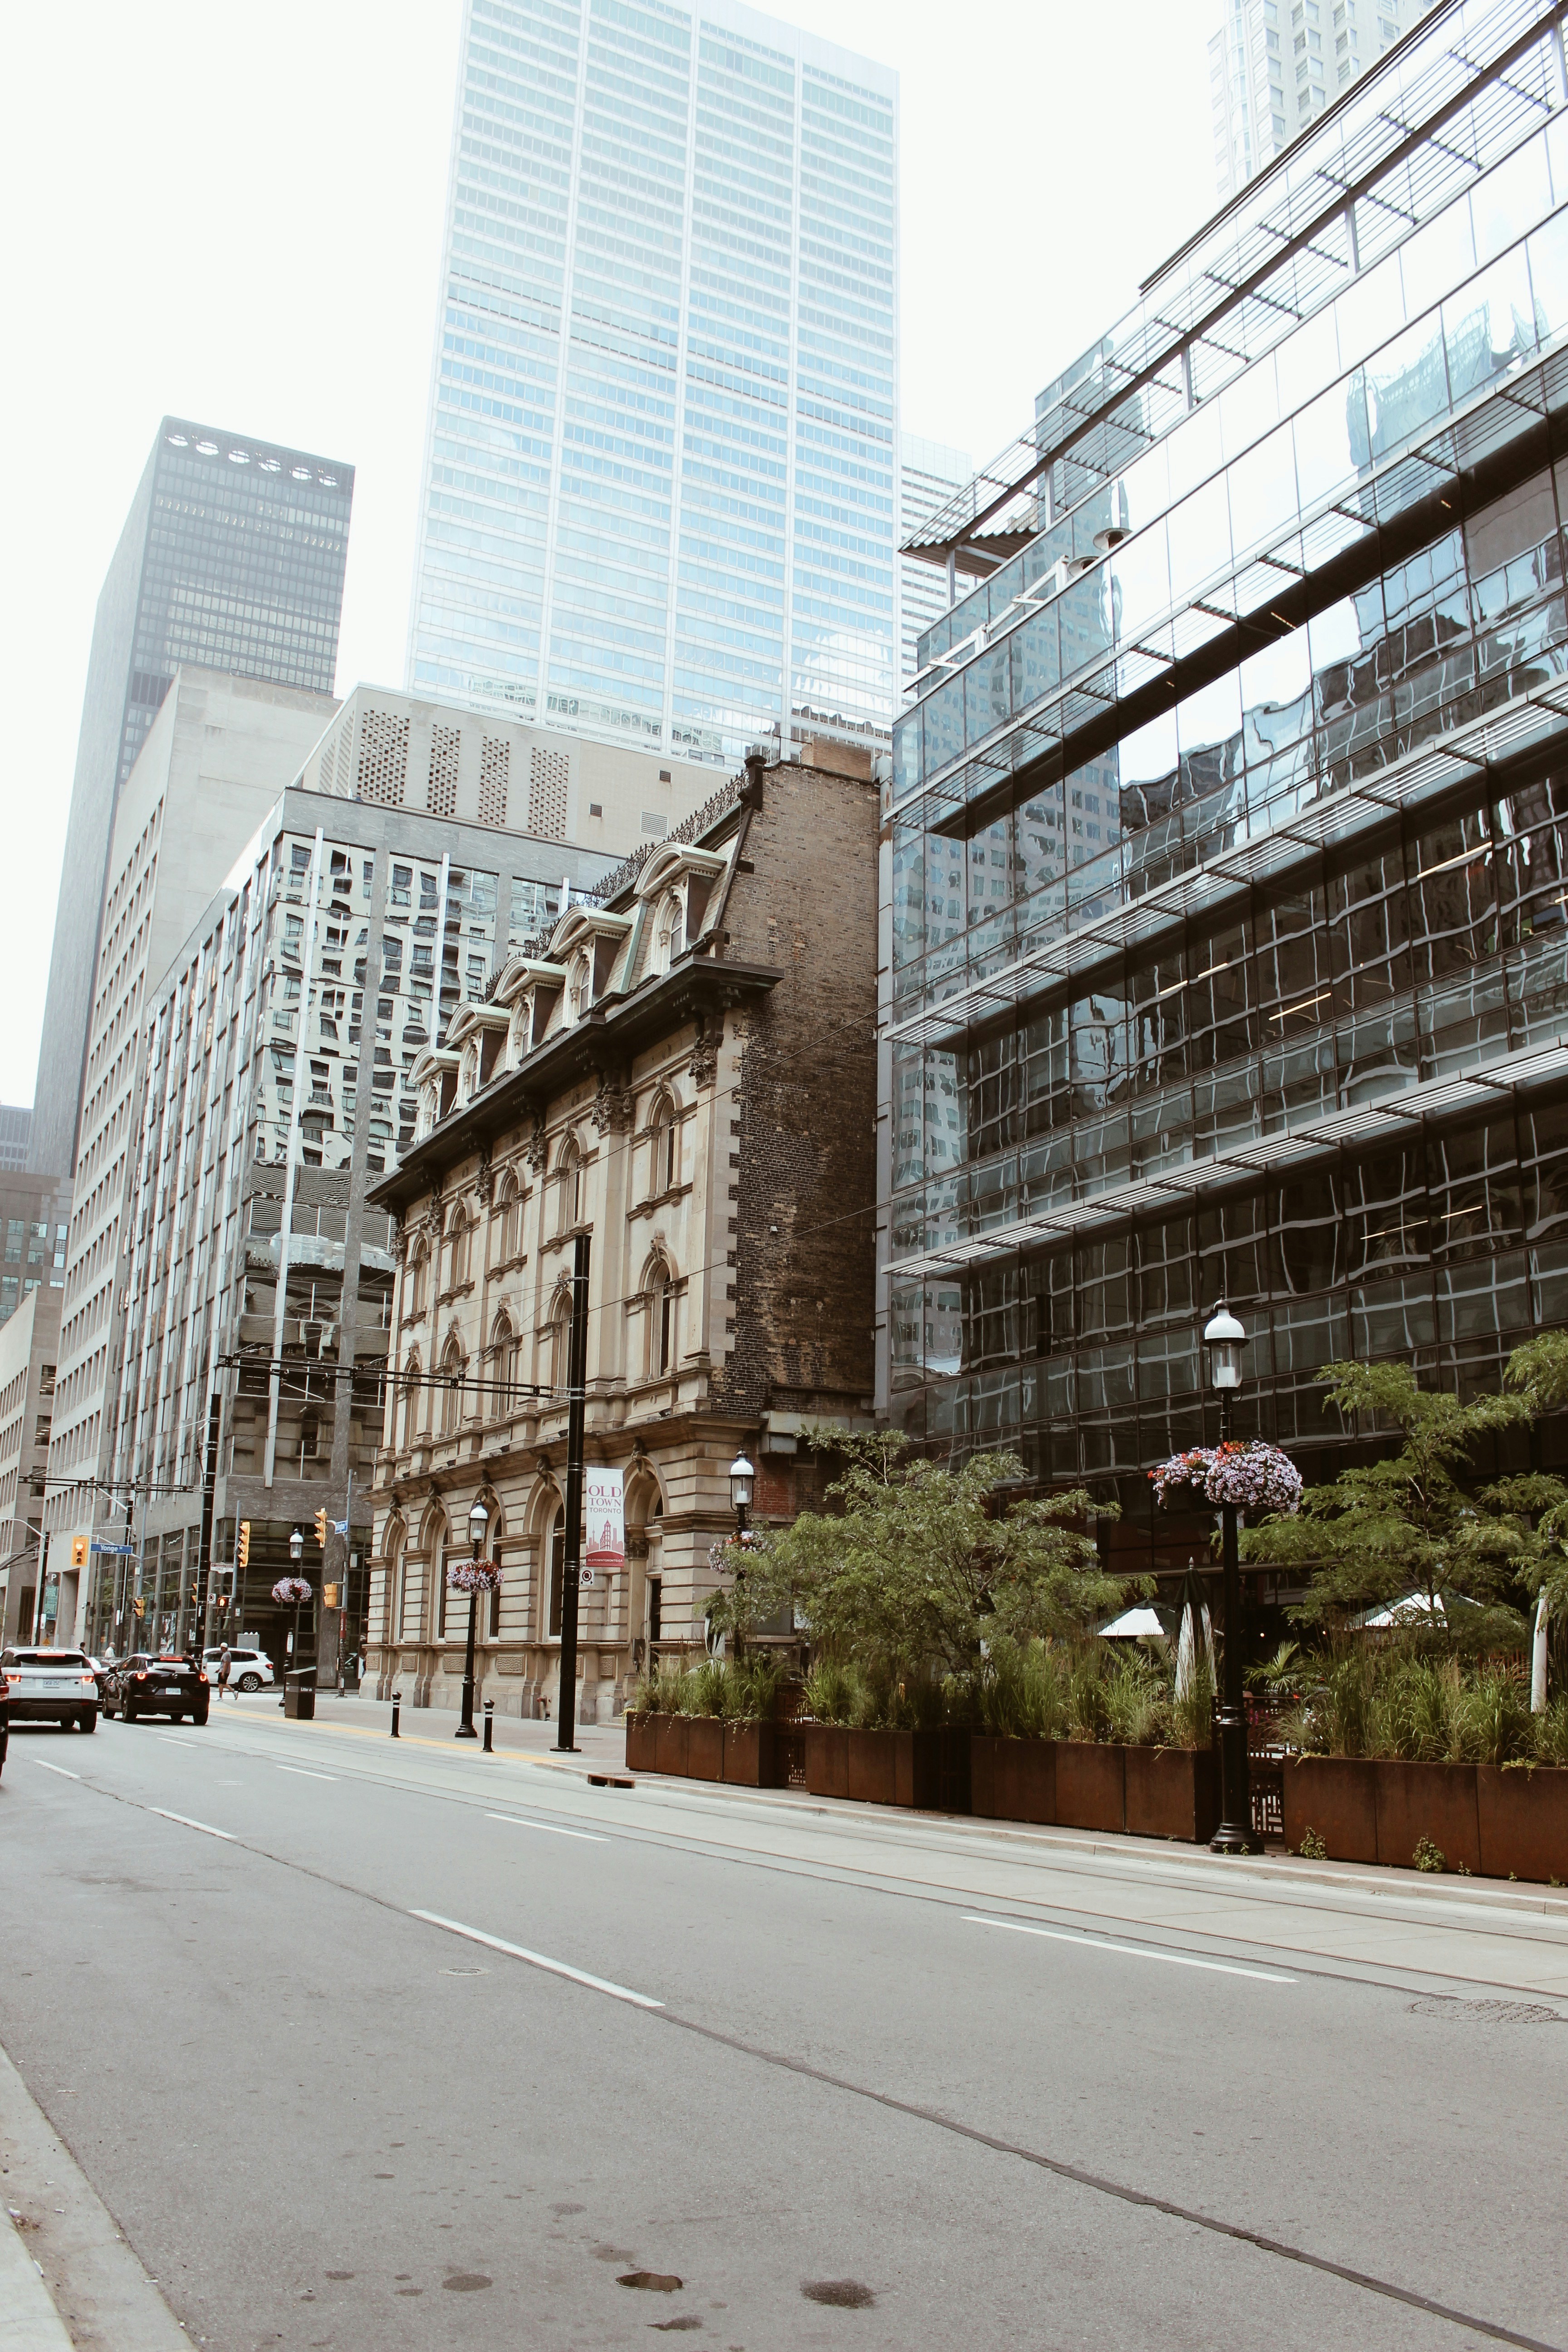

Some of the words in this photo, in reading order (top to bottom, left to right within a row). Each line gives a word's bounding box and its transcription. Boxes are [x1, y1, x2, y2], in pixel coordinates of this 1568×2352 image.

[588, 1485, 621, 1497] OLD
[588, 1498, 622, 1507] TOWN
[100, 1544, 118, 1553] Yonge
